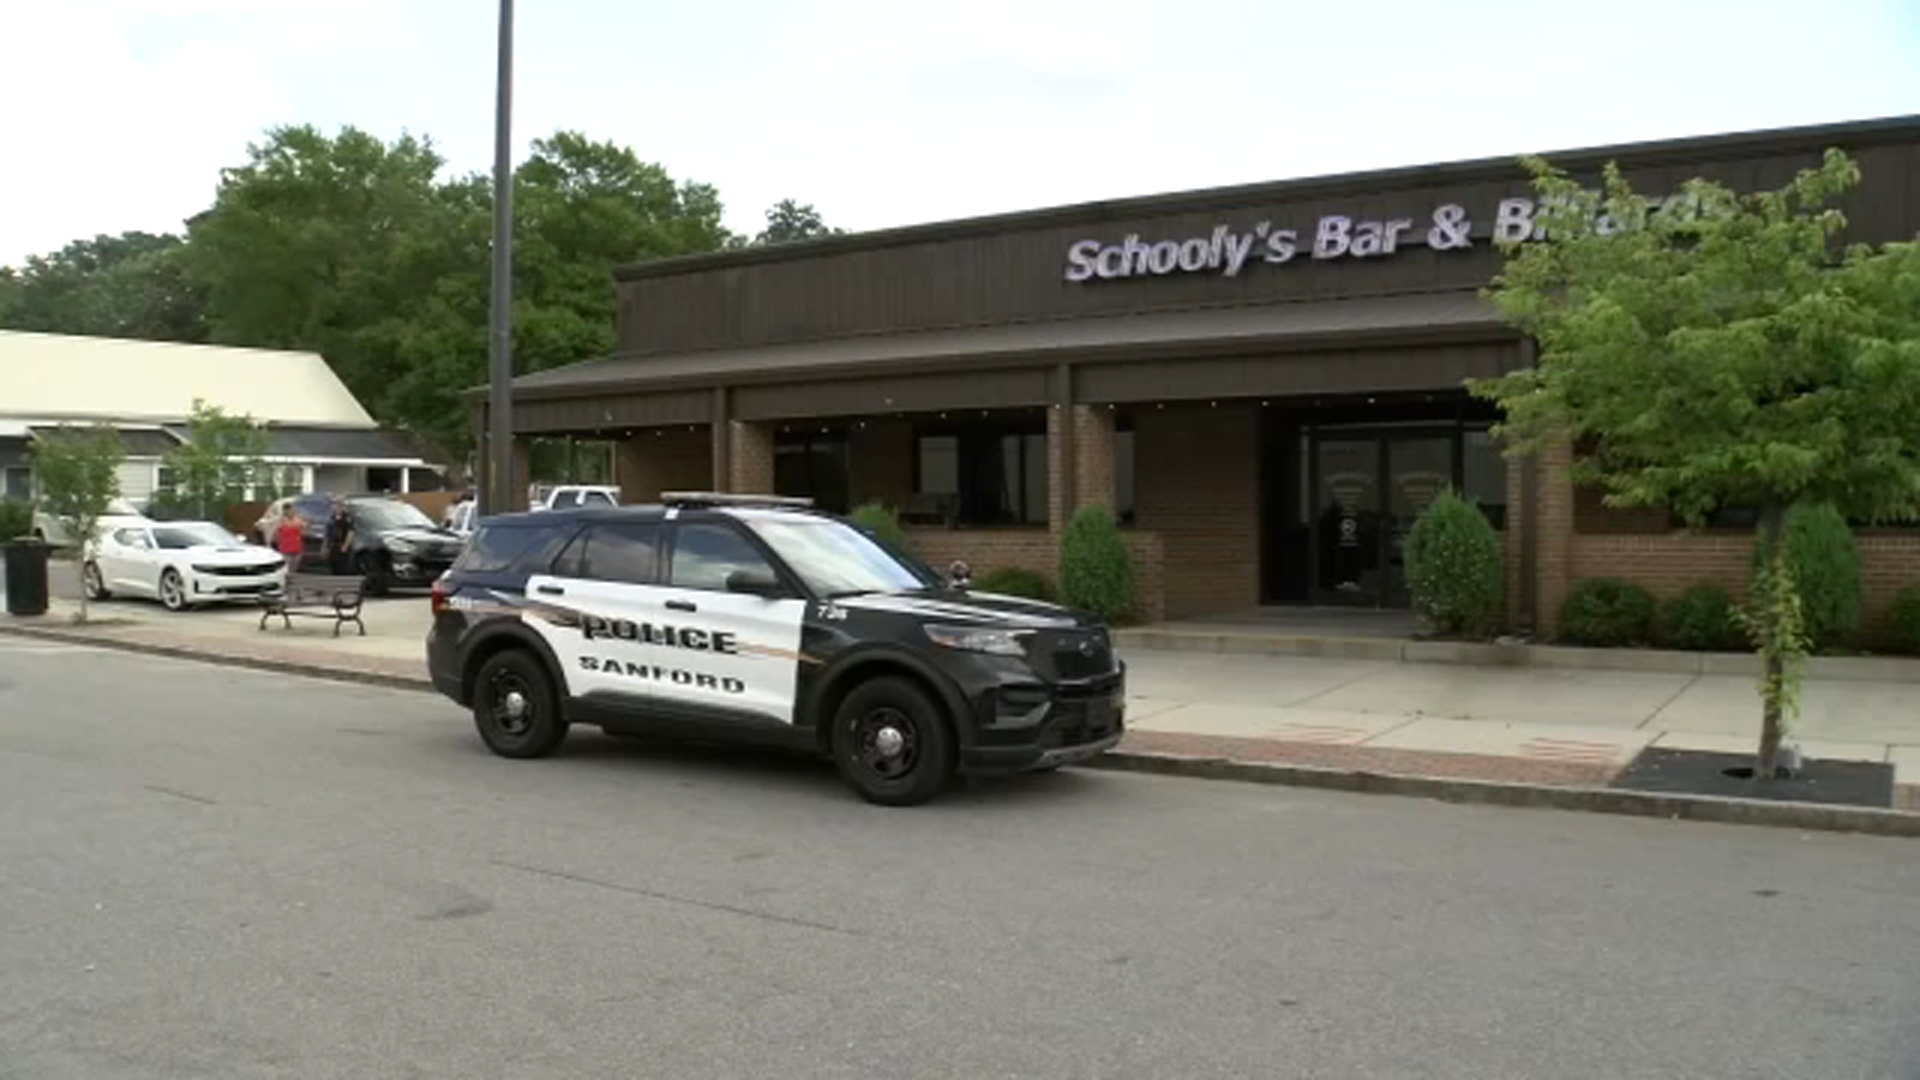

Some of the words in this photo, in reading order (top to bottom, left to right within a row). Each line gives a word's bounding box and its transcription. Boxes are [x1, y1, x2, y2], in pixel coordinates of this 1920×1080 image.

[1066, 220, 1297, 281] Schooly's
[1314, 215, 1412, 259] Bar
[1427, 203, 1473, 251] &
[581, 613, 739, 655] POLICE
[578, 655, 745, 693] SANFORD
